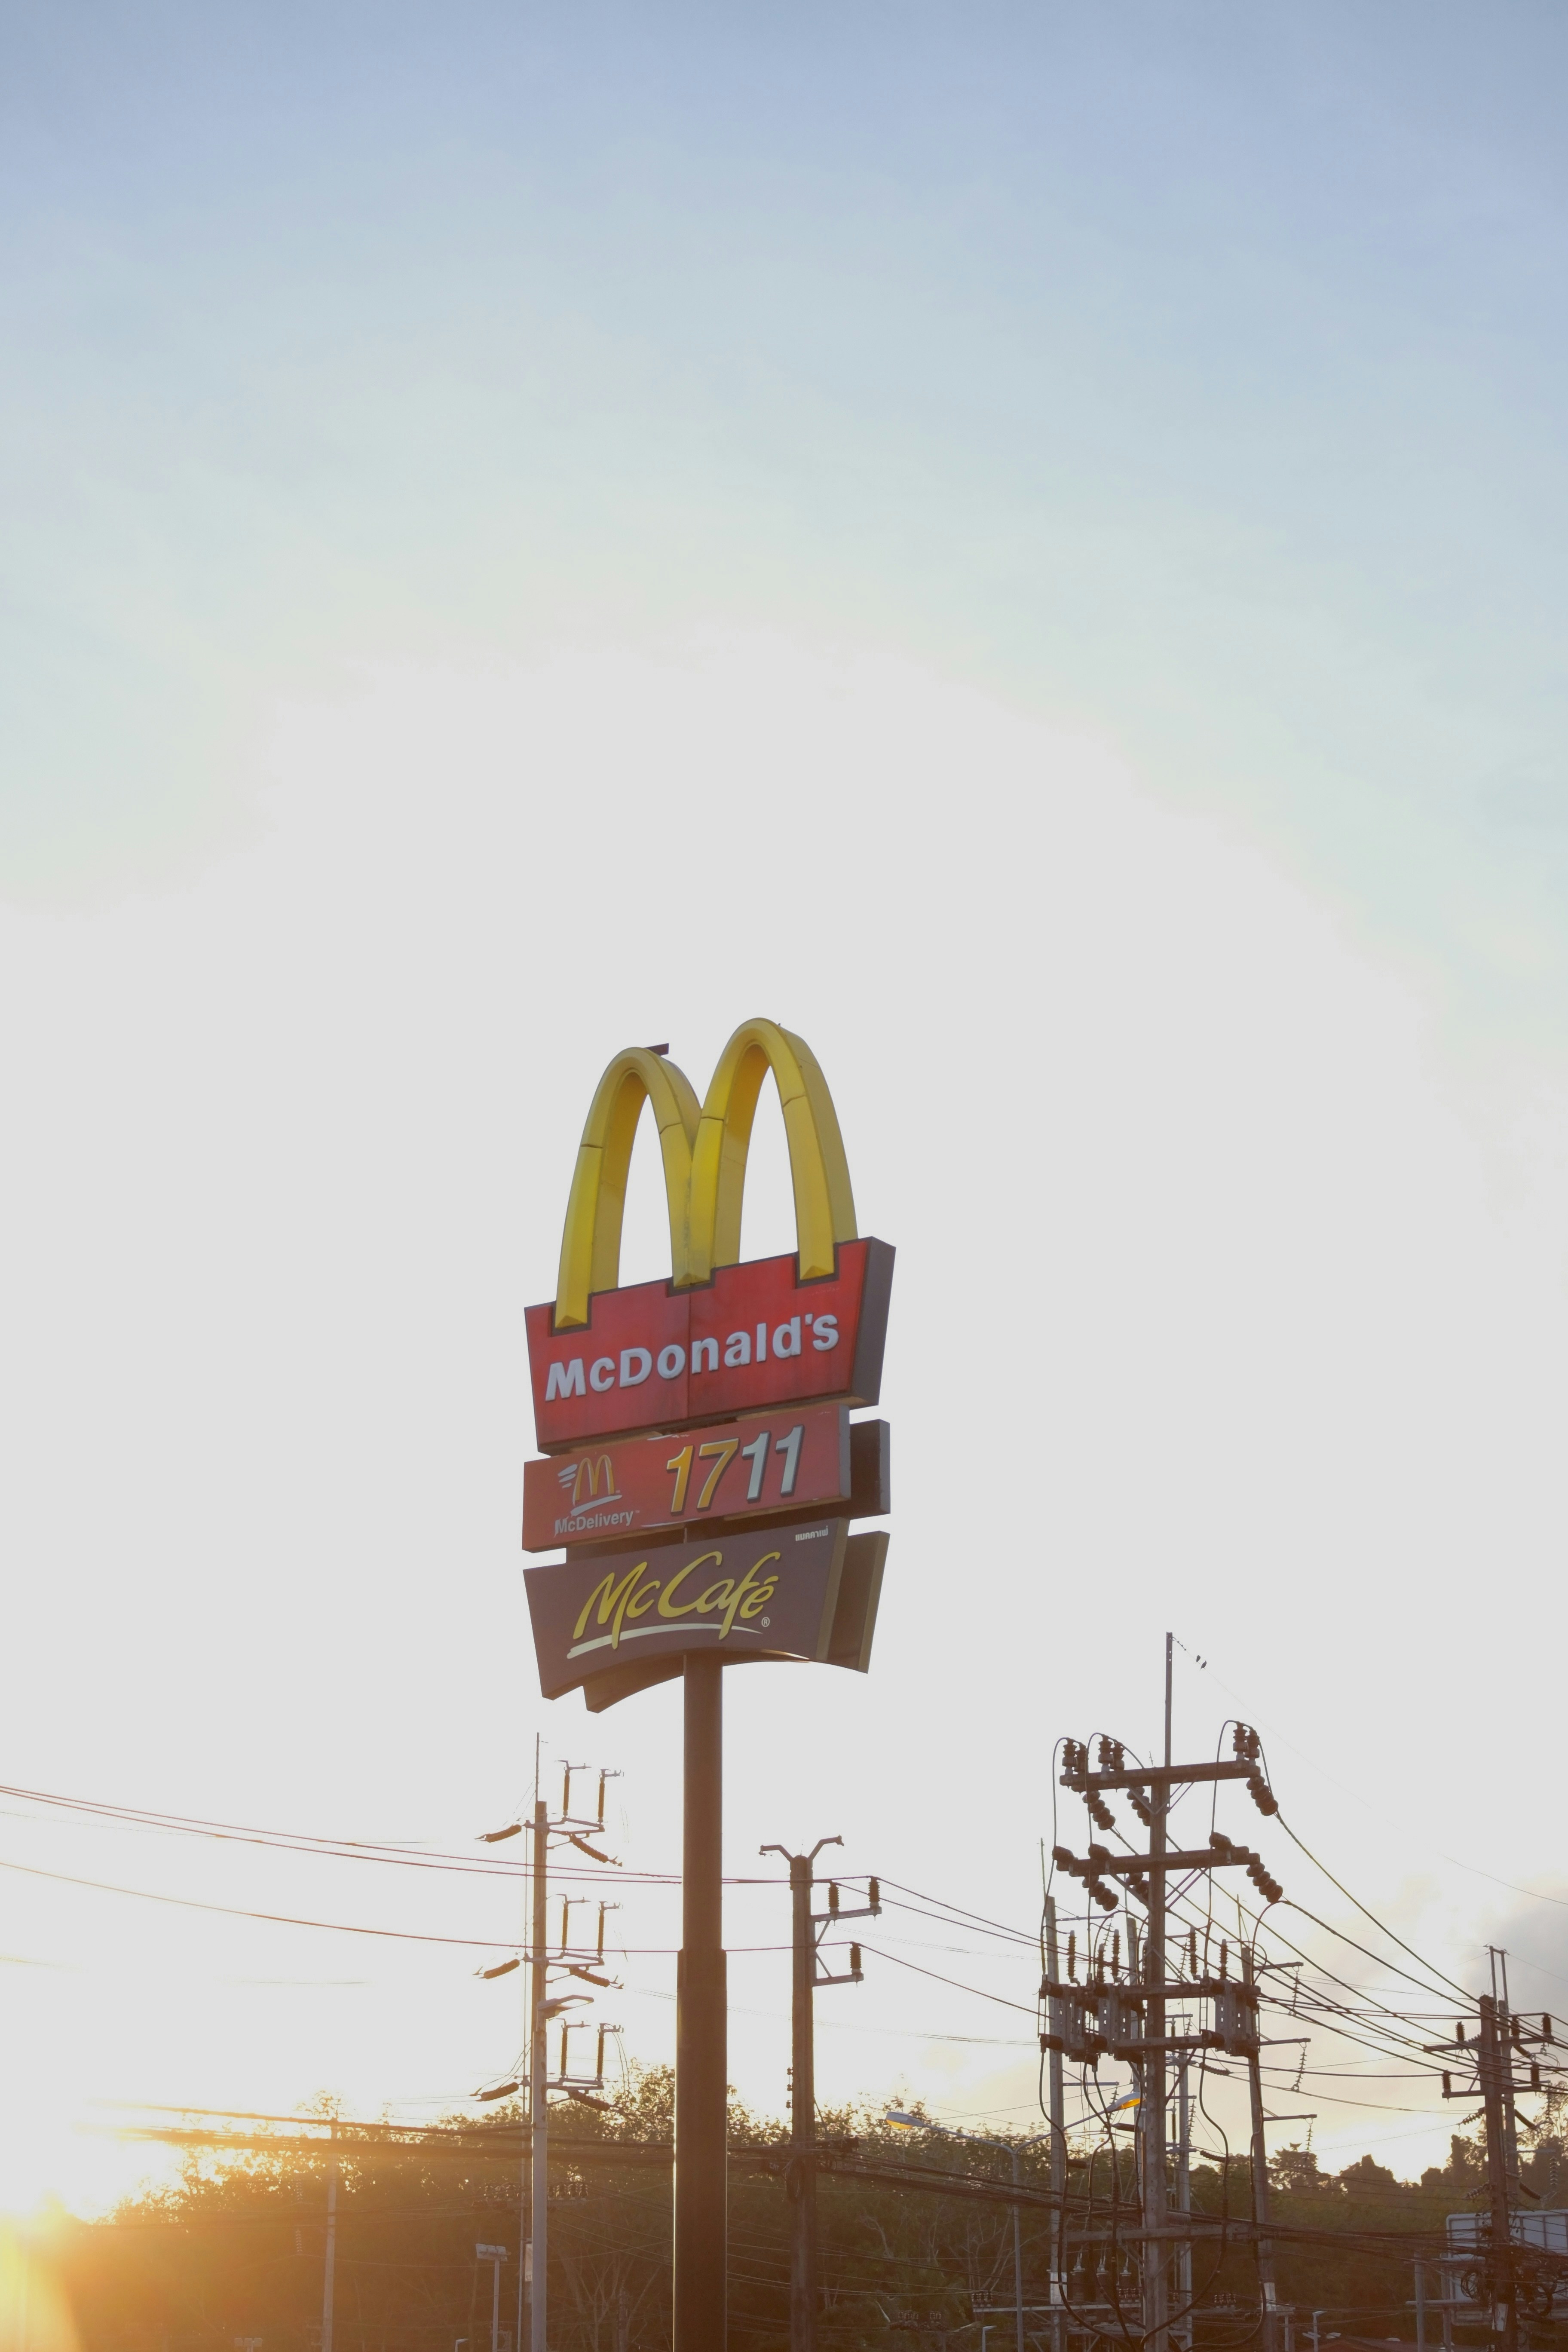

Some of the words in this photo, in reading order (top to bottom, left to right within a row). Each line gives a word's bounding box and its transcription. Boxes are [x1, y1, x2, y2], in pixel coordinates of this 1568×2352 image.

[545, 1313, 839, 1402] McDonald's
[666, 1425, 805, 1516] 1711
[573, 1551, 781, 1650] McCafé
